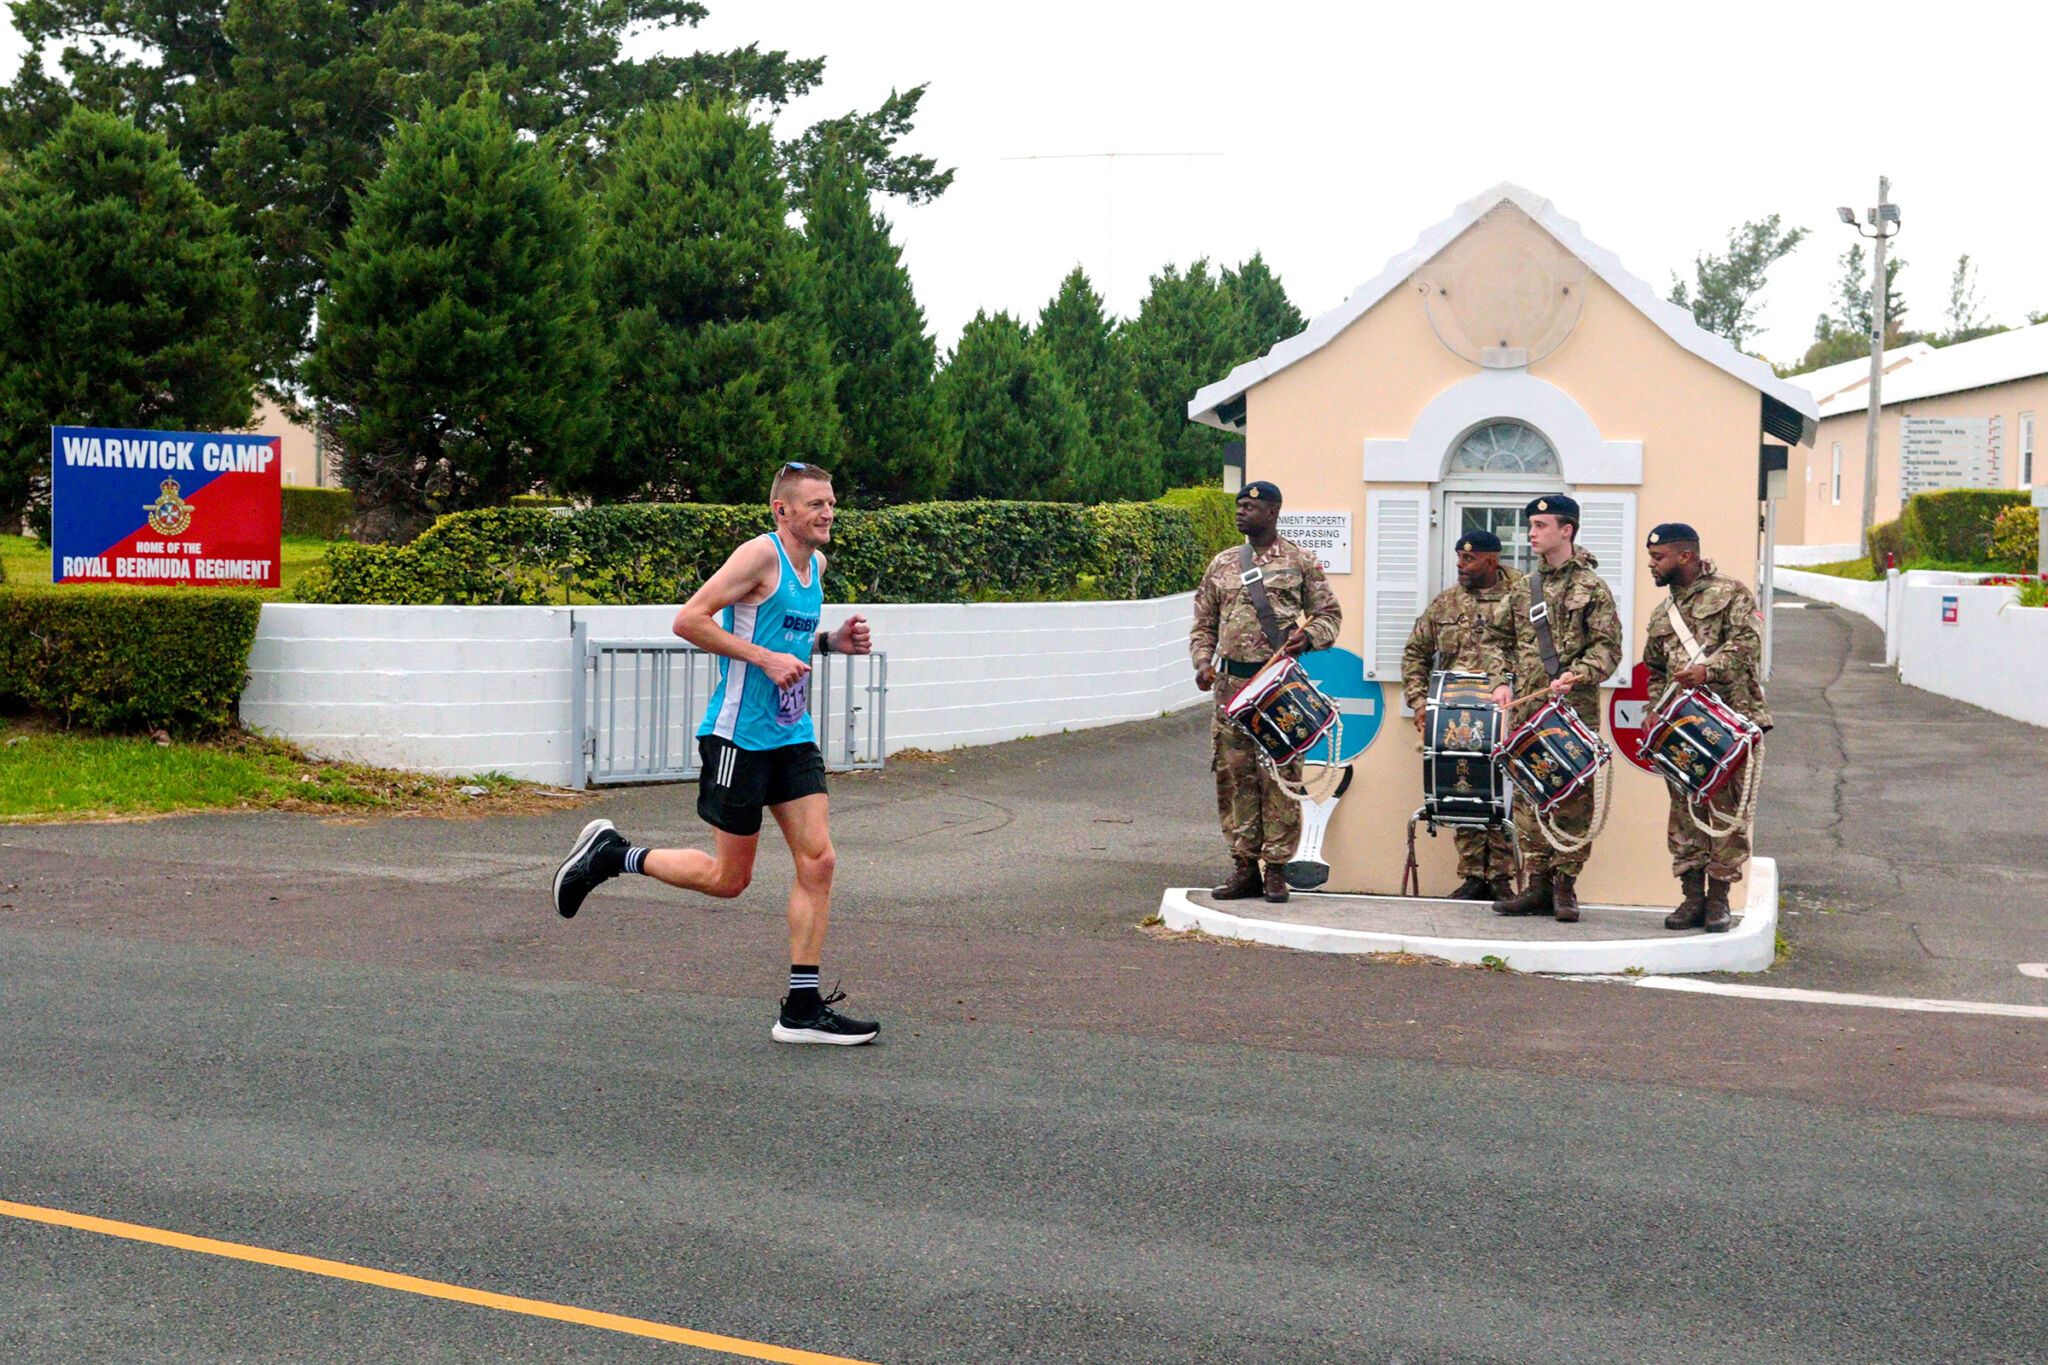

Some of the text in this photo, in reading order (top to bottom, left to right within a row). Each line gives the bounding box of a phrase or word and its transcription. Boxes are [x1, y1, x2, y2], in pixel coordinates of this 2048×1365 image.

[62, 436, 274, 473] WARWICK CAMP
[1306, 515, 1346, 525] PROPERTY
[136, 541, 202, 554] HOME OF THE
[63, 557, 271, 580] ROYAL BERMUDA REGIMENT
[782, 615, 818, 633] DERBY
